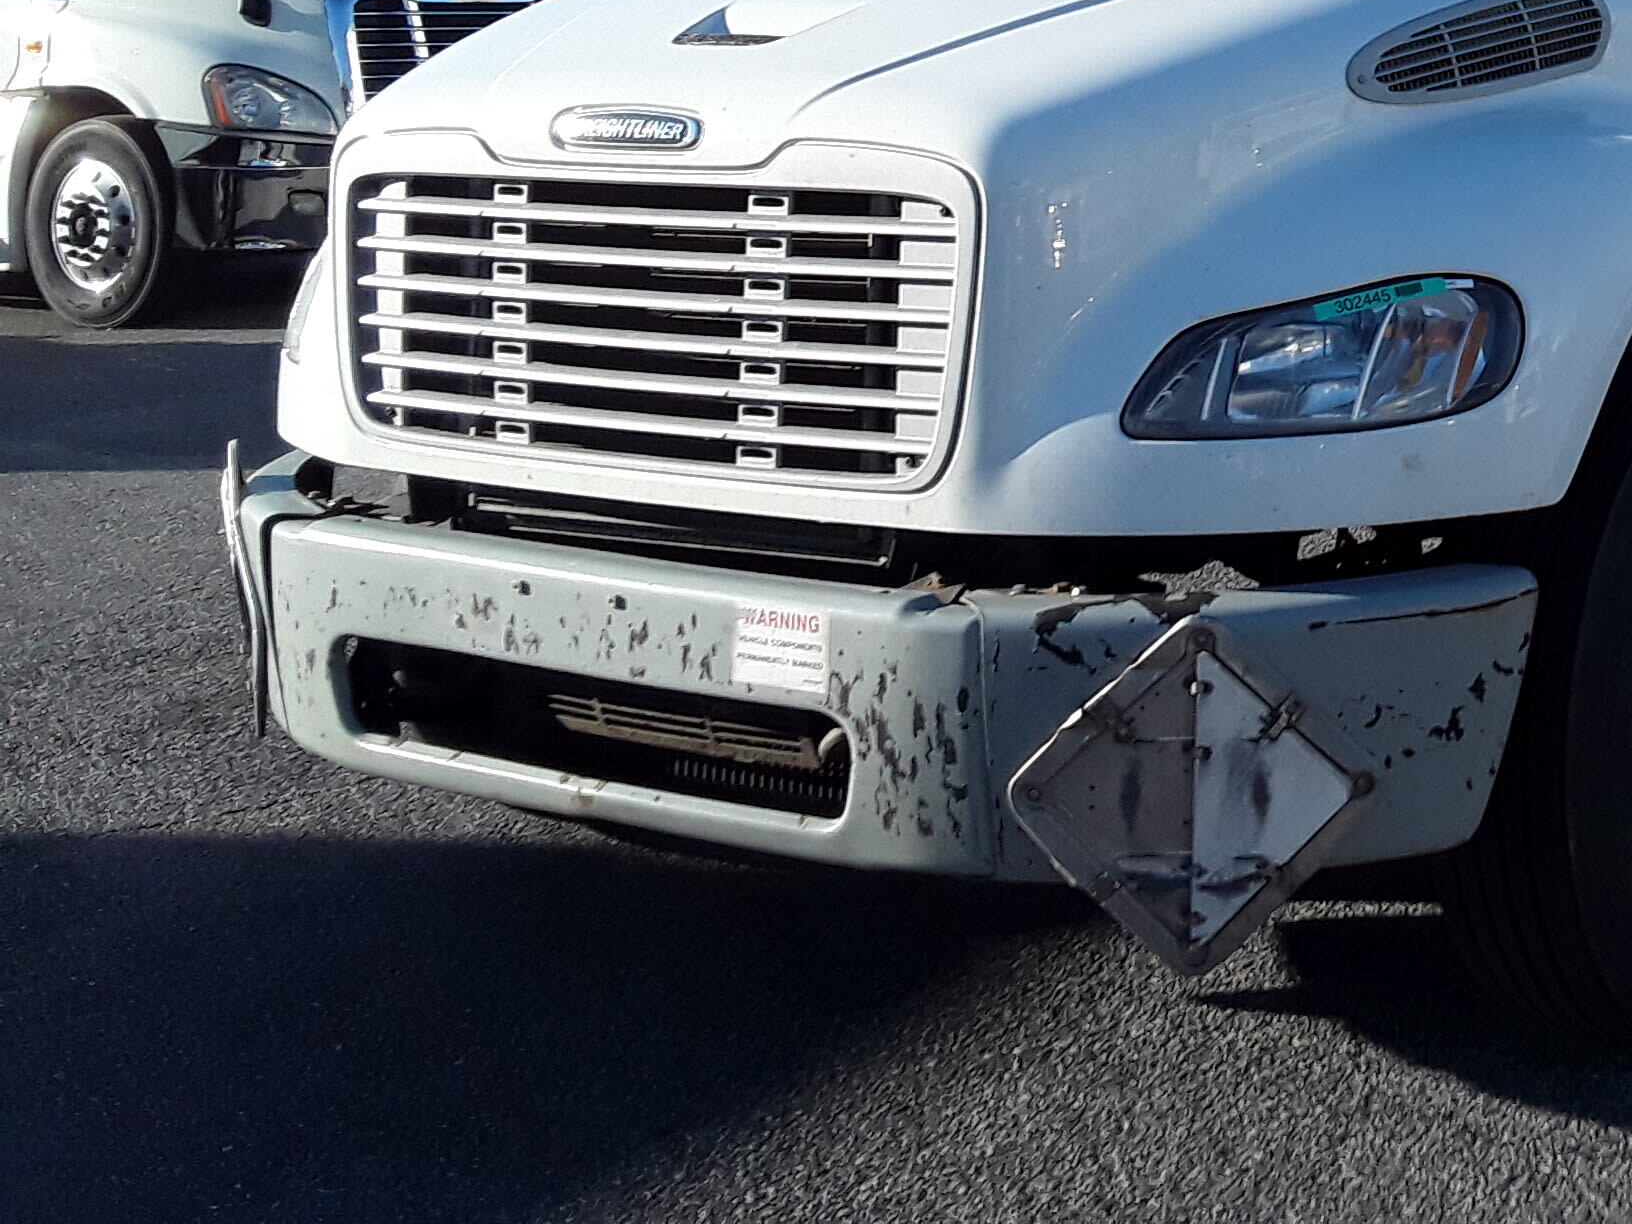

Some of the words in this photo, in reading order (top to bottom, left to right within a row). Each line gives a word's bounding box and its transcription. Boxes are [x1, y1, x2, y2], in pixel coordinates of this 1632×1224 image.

[574, 118, 686, 140] EIGHTLINER
[1333, 289, 1391, 314] 302445
[740, 607, 820, 633] WARNING
